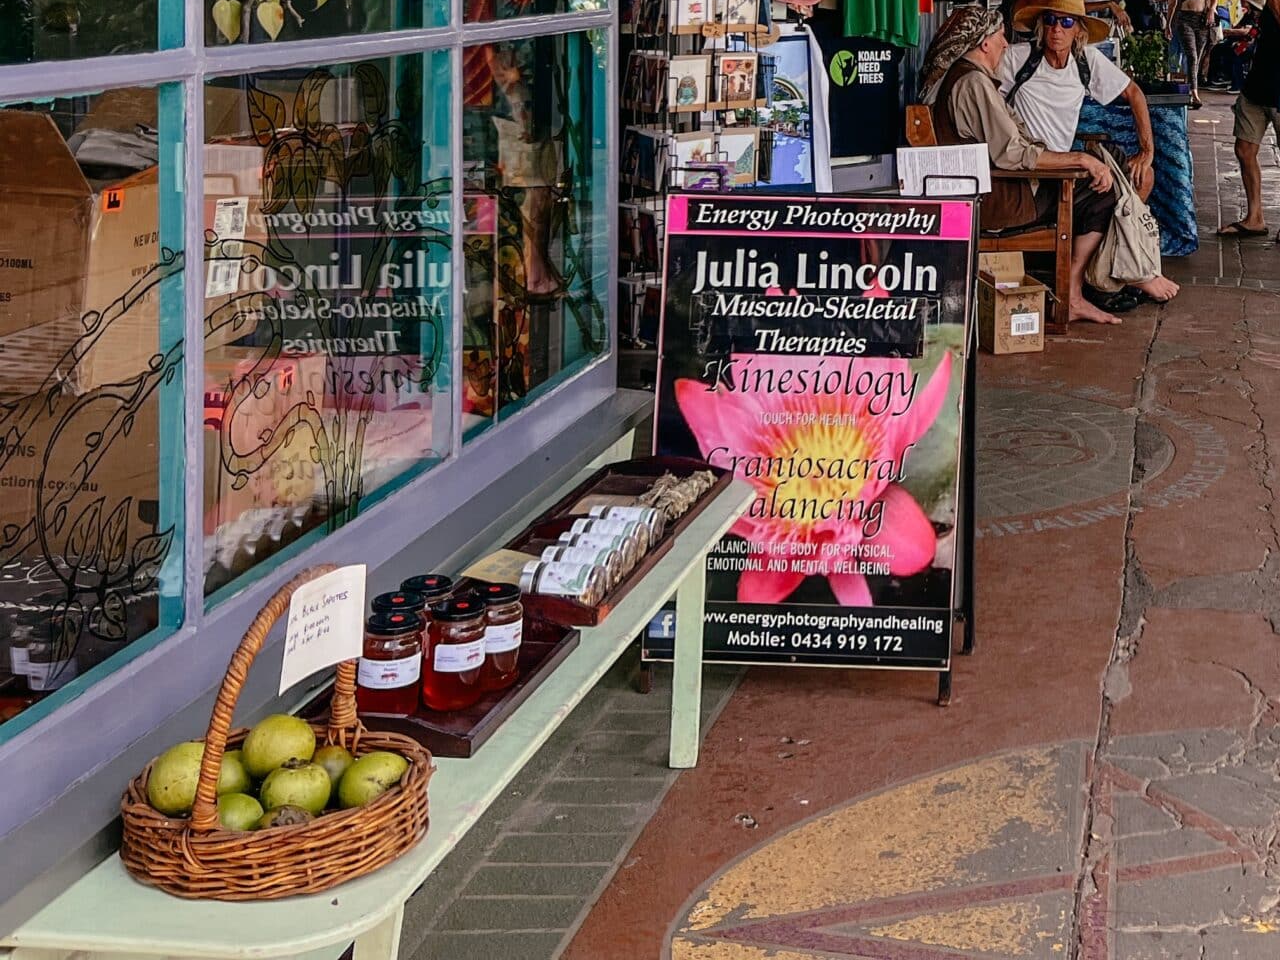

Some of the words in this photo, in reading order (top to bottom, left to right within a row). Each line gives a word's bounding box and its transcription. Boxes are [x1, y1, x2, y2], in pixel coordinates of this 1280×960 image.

[858, 50, 891, 61] KOALAS
[858, 62, 880, 73] NEED
[858, 73, 884, 84] TREES
[696, 204, 779, 230] Energy
[783, 206, 937, 237] Photography
[692, 250, 780, 295] Julia
[797, 252, 939, 292] Lincoln
[711, 295, 918, 321] Musculo-Skeletal
[755, 329, 867, 356] Therapies
[704, 358, 920, 416] Kinesiology
[760, 411, 794, 425] TOUCH
[796, 412, 817, 425] FOR
[819, 412, 857, 426] HEALTH
[749, 480, 888, 539] alancing
[768, 542, 787, 555] THE
[790, 543, 819, 556] BODY
[821, 543, 841, 557] FOR
[843, 544, 896, 559] PHYSICAL,
[707, 557, 764, 572] EMOTIONAL
[767, 559, 788, 573] AND
[791, 559, 830, 574] MENTAL
[833, 561, 891, 576] WELLBEING
[727, 630, 786, 647] Mobile:
[791, 632, 833, 648] 0434
[837, 634, 868, 650] 919
[874, 635, 903, 651] 172
